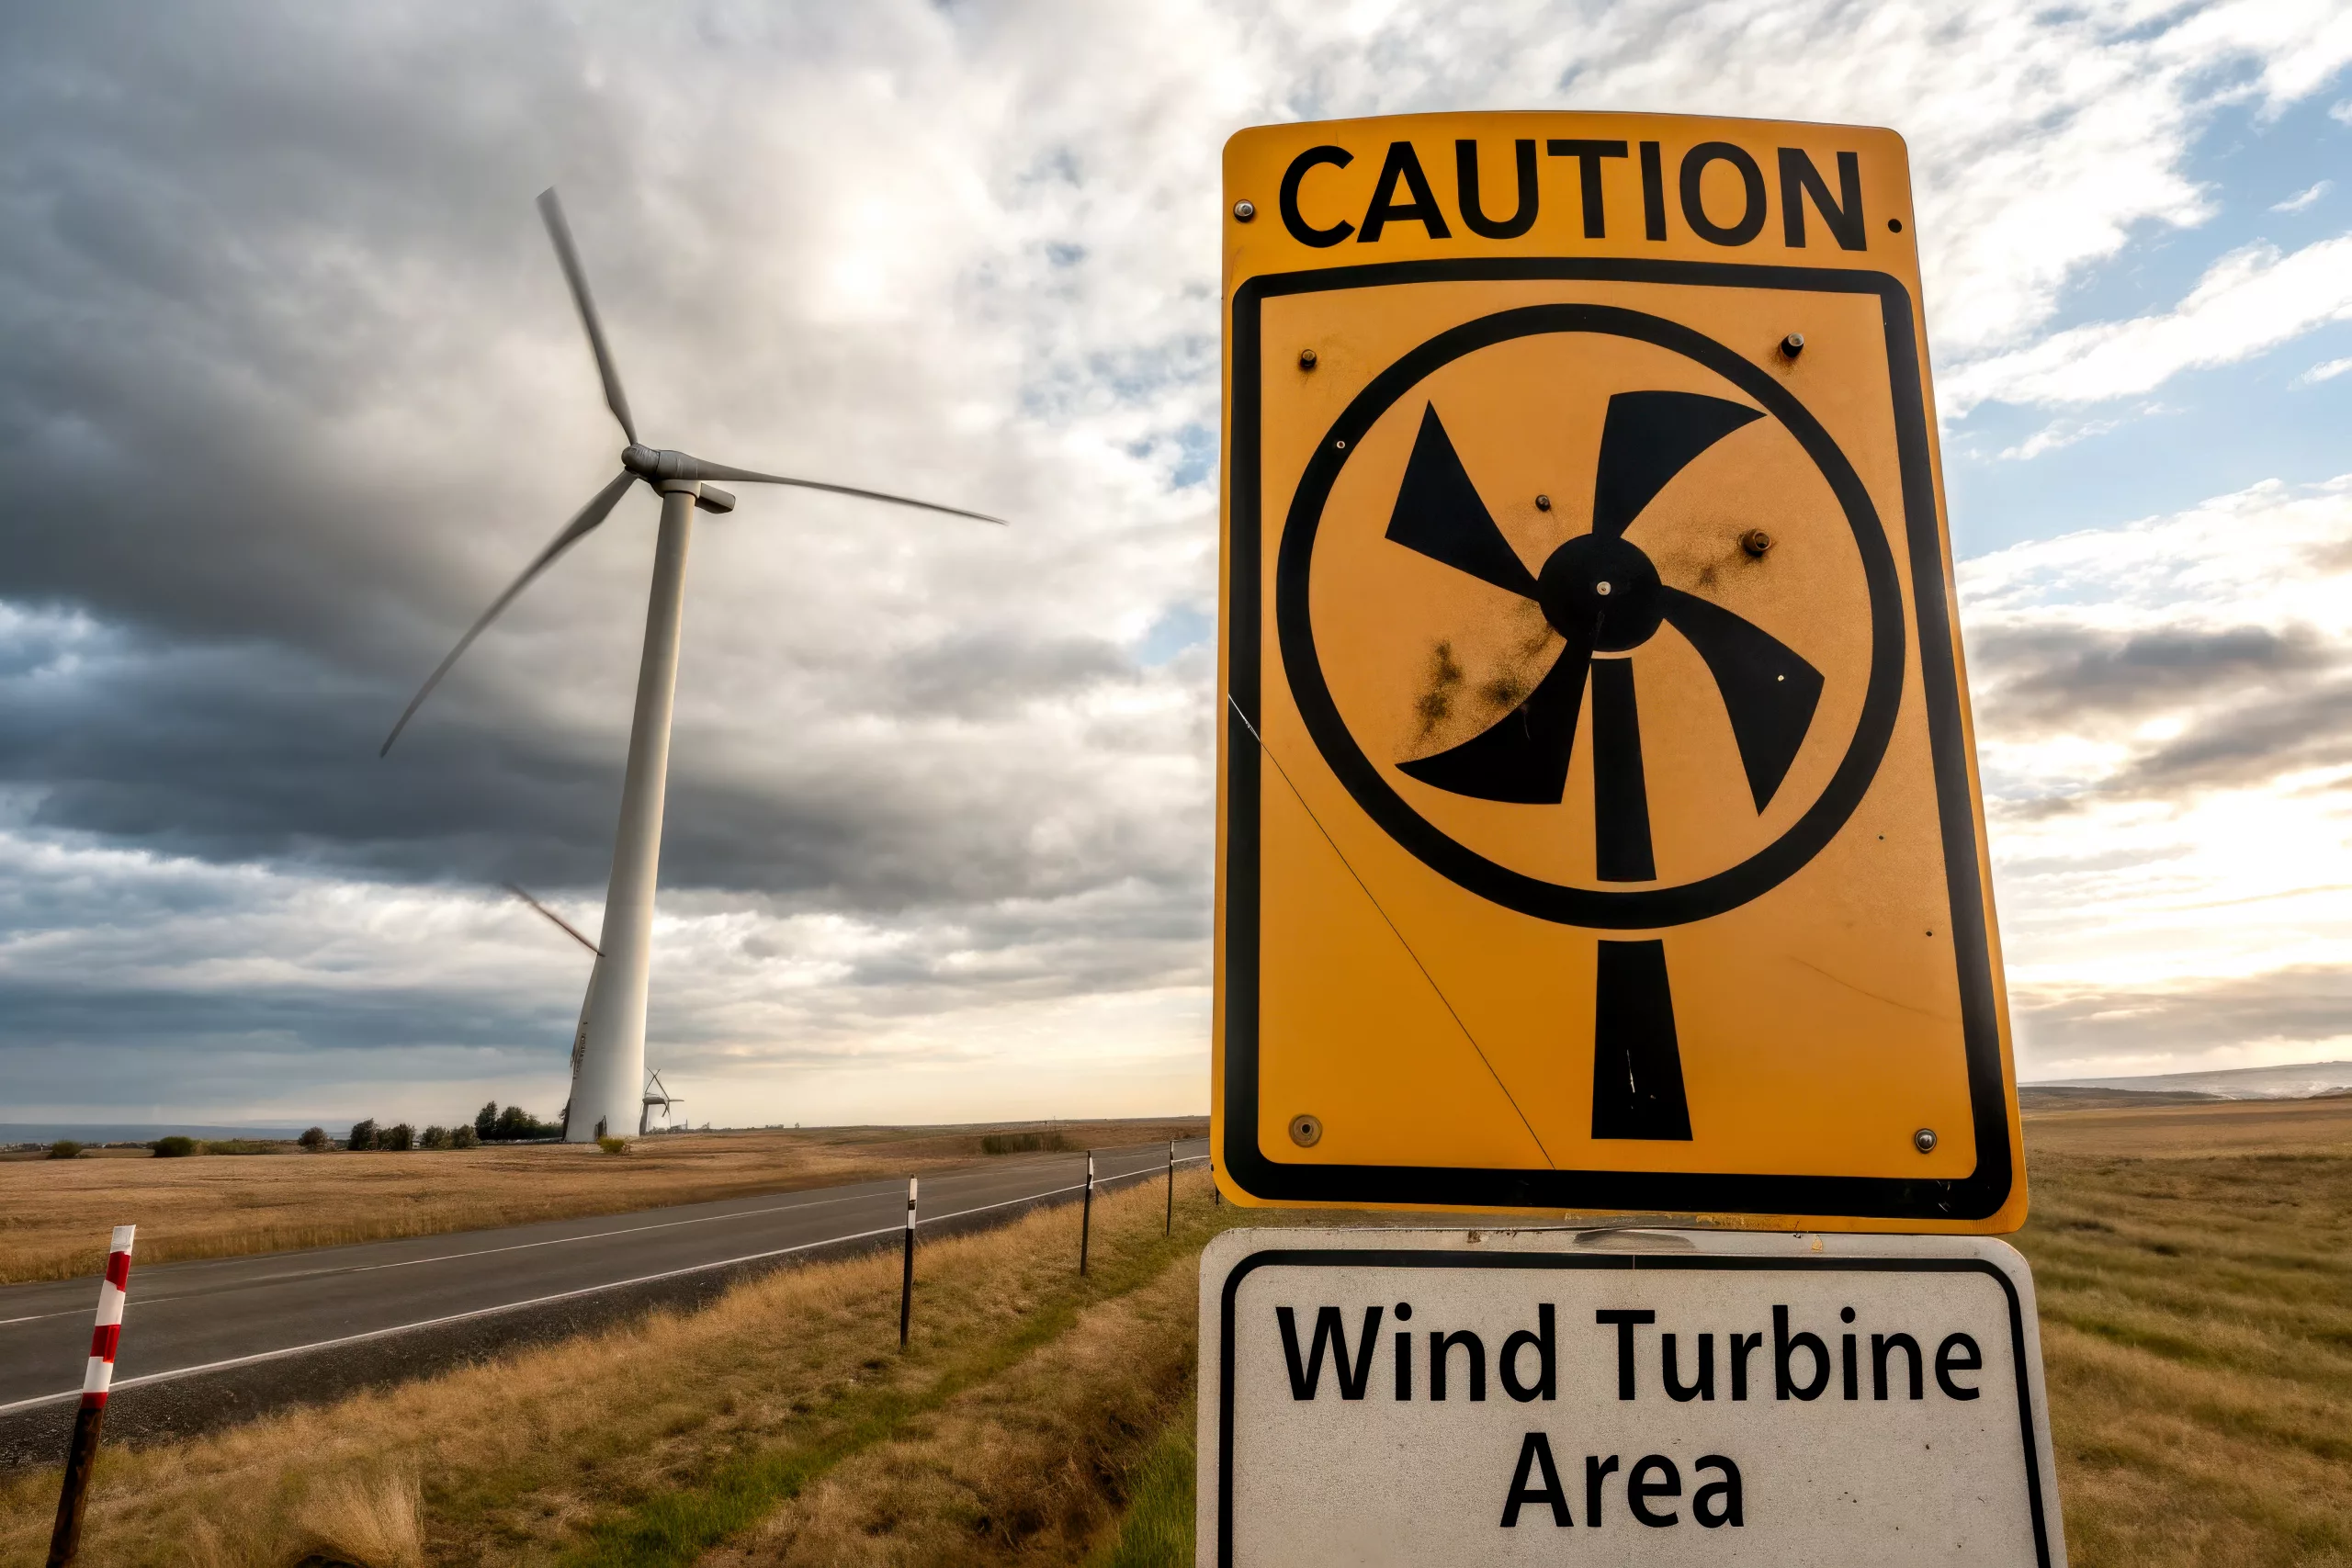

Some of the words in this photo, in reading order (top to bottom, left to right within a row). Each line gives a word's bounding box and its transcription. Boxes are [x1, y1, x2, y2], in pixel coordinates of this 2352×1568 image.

[1279, 139, 1868, 252] CAUTION
[1274, 1303, 1557, 1404] Wind
[1595, 1303, 1984, 1403] Turbine
[1498, 1430, 1745, 1529] Area
